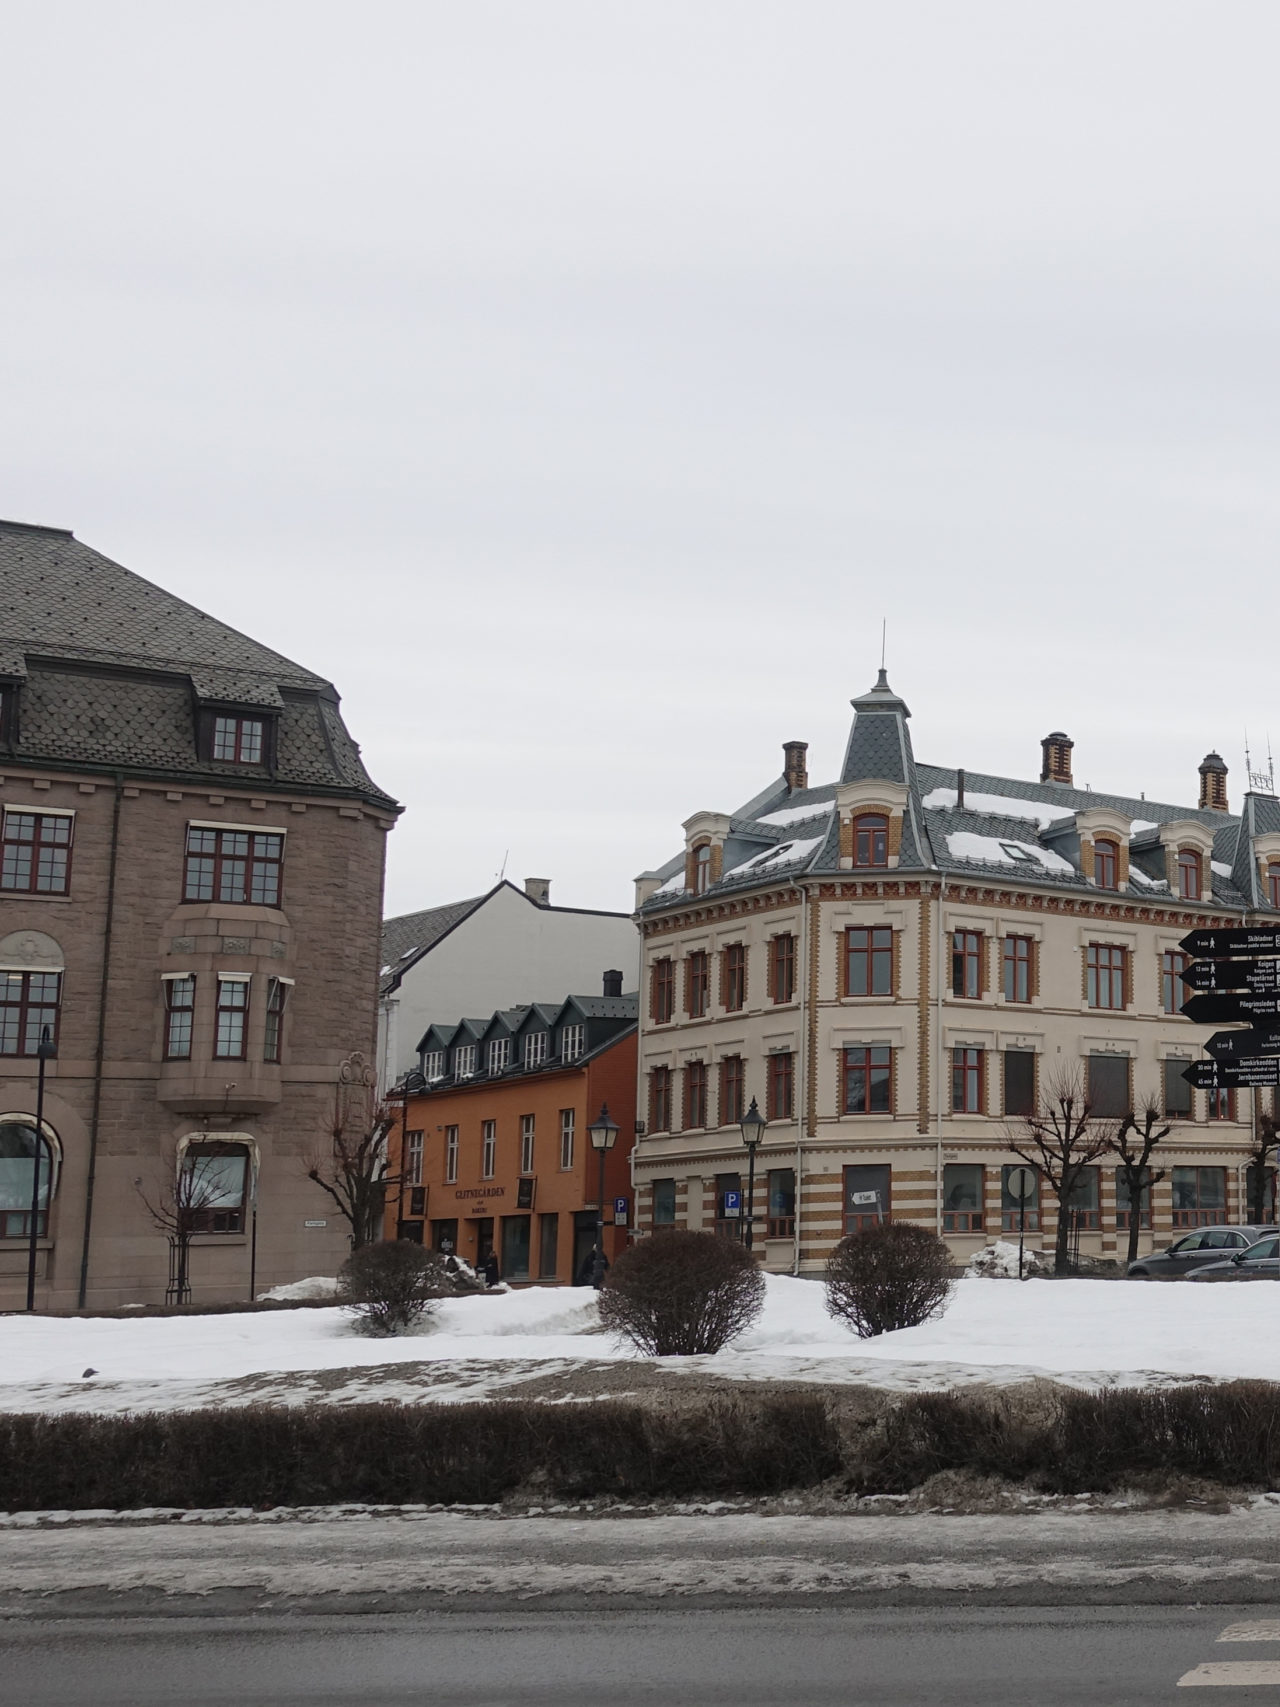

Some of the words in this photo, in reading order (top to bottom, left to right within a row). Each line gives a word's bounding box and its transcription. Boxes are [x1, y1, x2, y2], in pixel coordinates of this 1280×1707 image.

[1258, 961, 1275, 969] Koigen
[1239, 1000, 1276, 1008] Pilegrimsleden
[1240, 1059, 1278, 1067] Domkirkeodden
[1238, 1073, 1278, 1081] Jernbanemuseet
[729, 1194, 736, 1206] P
[617, 1200, 625, 1212] P
